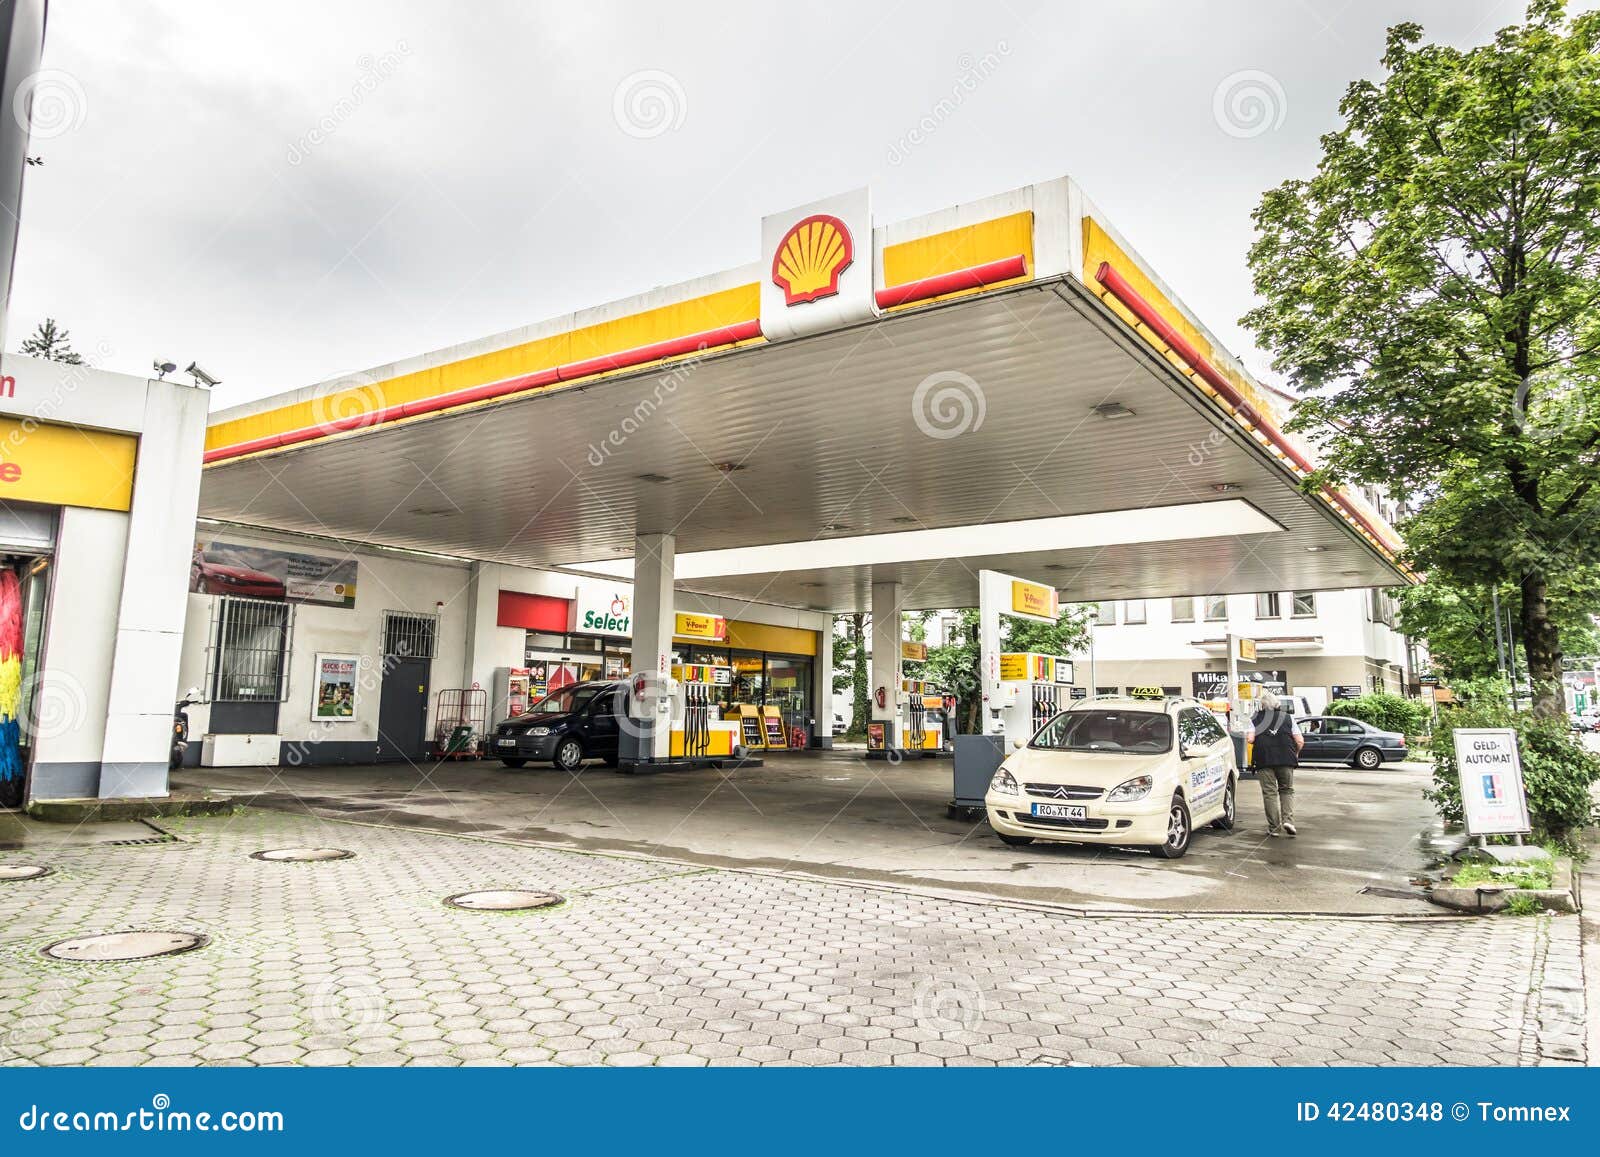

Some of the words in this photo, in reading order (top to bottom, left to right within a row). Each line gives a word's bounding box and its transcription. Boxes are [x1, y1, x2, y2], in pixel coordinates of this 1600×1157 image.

[583, 609, 630, 632] Select
[1134, 687, 1160, 695] TAXI
[1473, 740, 1500, 751] GELD-
[1465, 753, 1511, 764] AUTOMAT
[1040, 805, 1052, 815] RO
[1057, 806, 1069, 817] XT
[1070, 807, 1082, 817] 44
